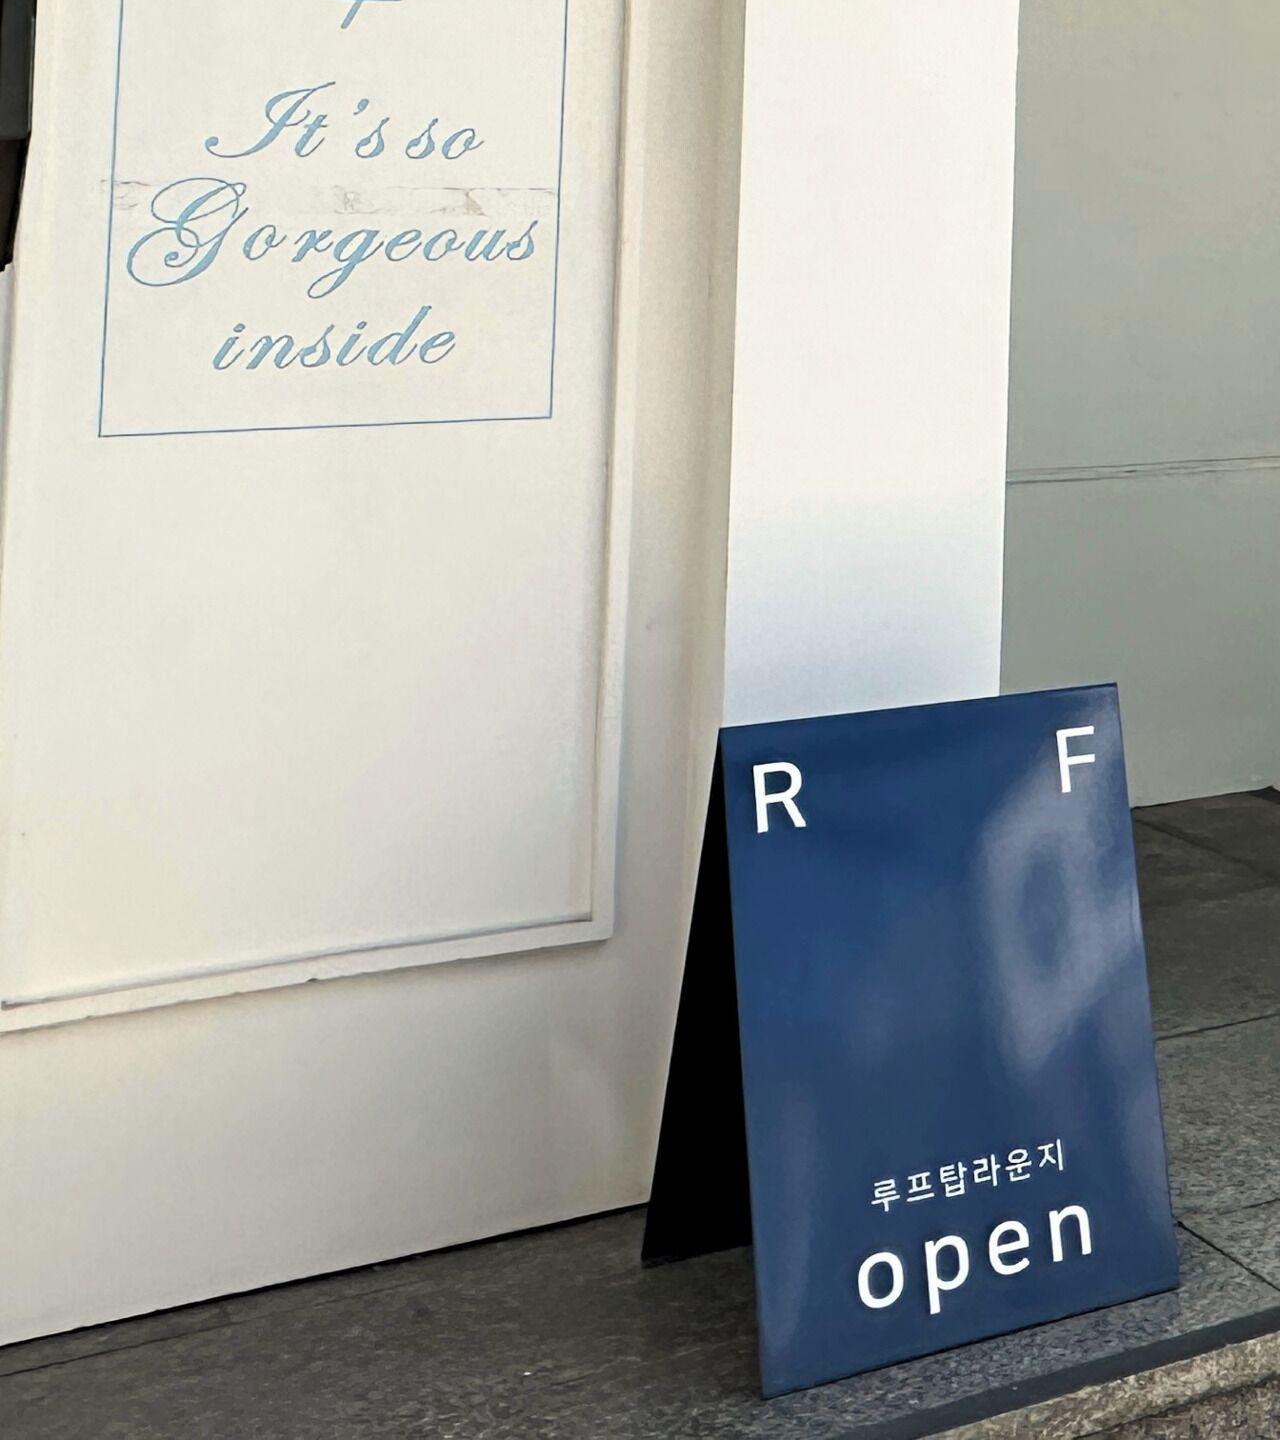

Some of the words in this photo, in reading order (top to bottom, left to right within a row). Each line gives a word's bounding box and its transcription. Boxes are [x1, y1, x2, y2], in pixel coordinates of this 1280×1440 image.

[204, 81, 390, 159] It's
[405, 117, 485, 160] so
[125, 176, 539, 300] Gorgeous
[212, 304, 457, 371] inside
[752, 761, 807, 834] R
[1055, 725, 1096, 794] F
[870, 1138, 1064, 1212] 루프탑라운지
[857, 1204, 1093, 1315] open
